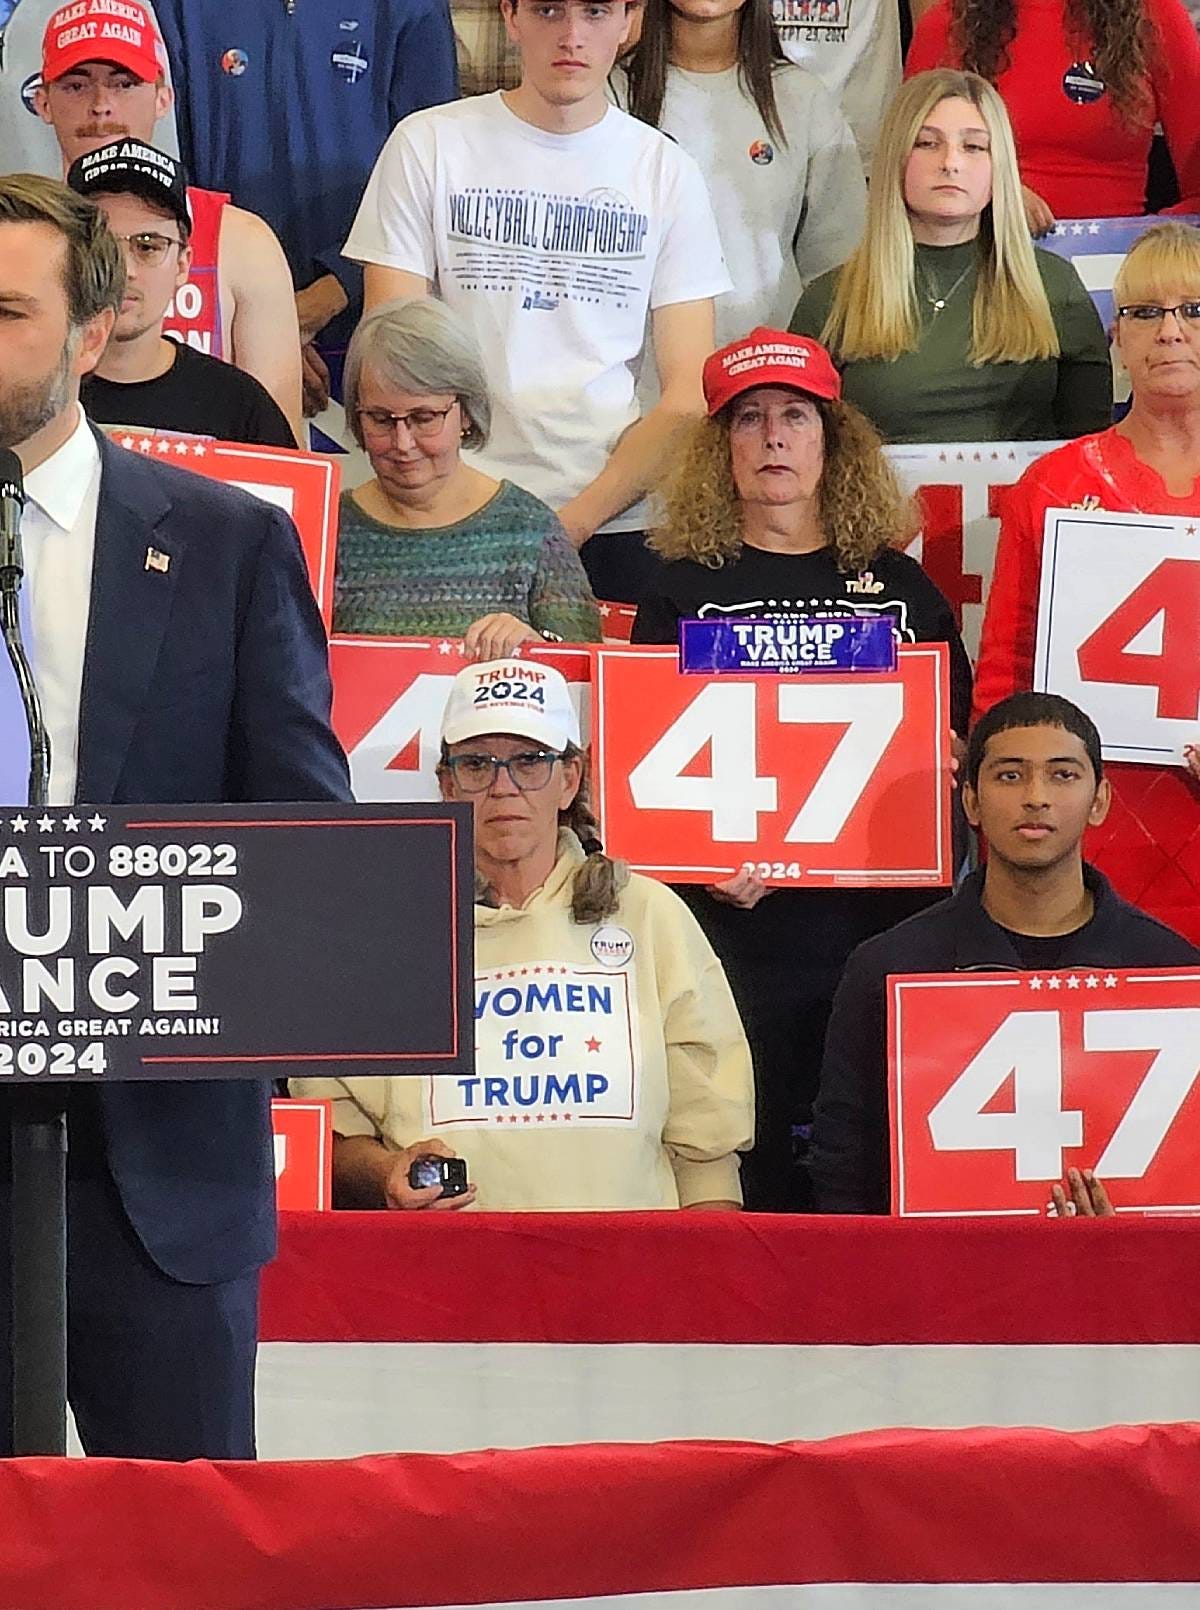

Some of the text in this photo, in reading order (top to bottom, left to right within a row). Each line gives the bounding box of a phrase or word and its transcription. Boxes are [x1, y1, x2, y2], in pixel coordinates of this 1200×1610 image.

[53, 0, 145, 29] MAKE AMERICA
[57, 22, 142, 49] GREAT AGAIN
[82, 143, 176, 176] MAKE AMERICA
[450, 193, 538, 249] VOLLEYBALL
[543, 201, 648, 253] CHAMPIONSHIP
[722, 344, 810, 368] MAKE AMERICA
[728, 355, 806, 376] GREAT AGAIN
[733, 624, 844, 645] TRUMP
[1076, 558, 1200, 720] 4
[746, 643, 832, 661] VANCE
[475, 667, 547, 685] TRUMP
[474, 682, 545, 705] 2024
[628, 682, 904, 843] 47
[40, 846, 96, 877] TO
[108, 844, 238, 877] 88022
[594, 941, 631, 949] TRUMP
[57, 1018, 132, 1036] GREAT
[139, 1017, 220, 1036] AGAIN!
[502, 1029, 563, 1060] for
[458, 1073, 609, 1107] TRUMP
[927, 1007, 1200, 1182] 47
